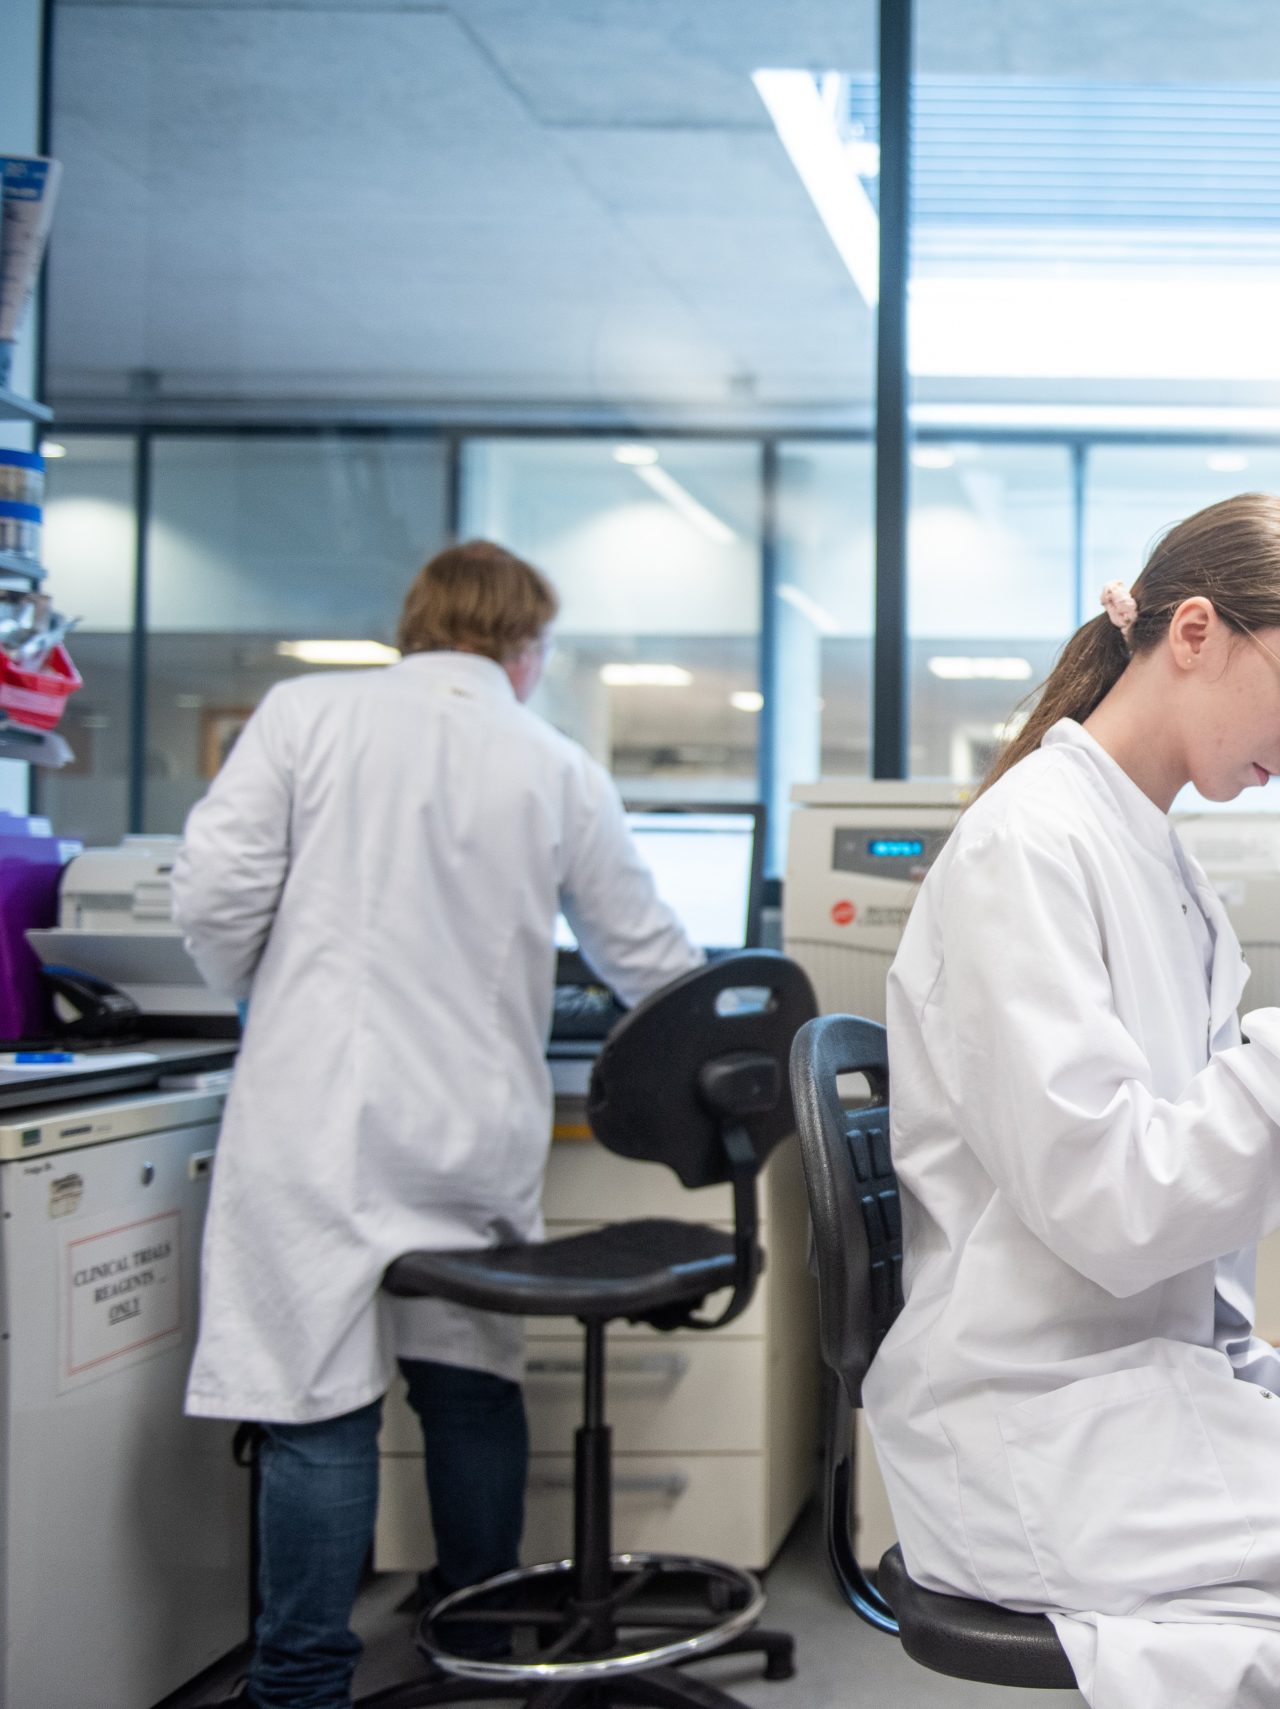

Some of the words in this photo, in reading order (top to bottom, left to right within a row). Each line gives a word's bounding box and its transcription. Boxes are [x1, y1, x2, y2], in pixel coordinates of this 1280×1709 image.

[74, 1256, 129, 1288] CLINICAL
[132, 1242, 171, 1268] TRIALS
[94, 1269, 155, 1304] REAGENTS
[108, 1298, 140, 1320] ONLY
